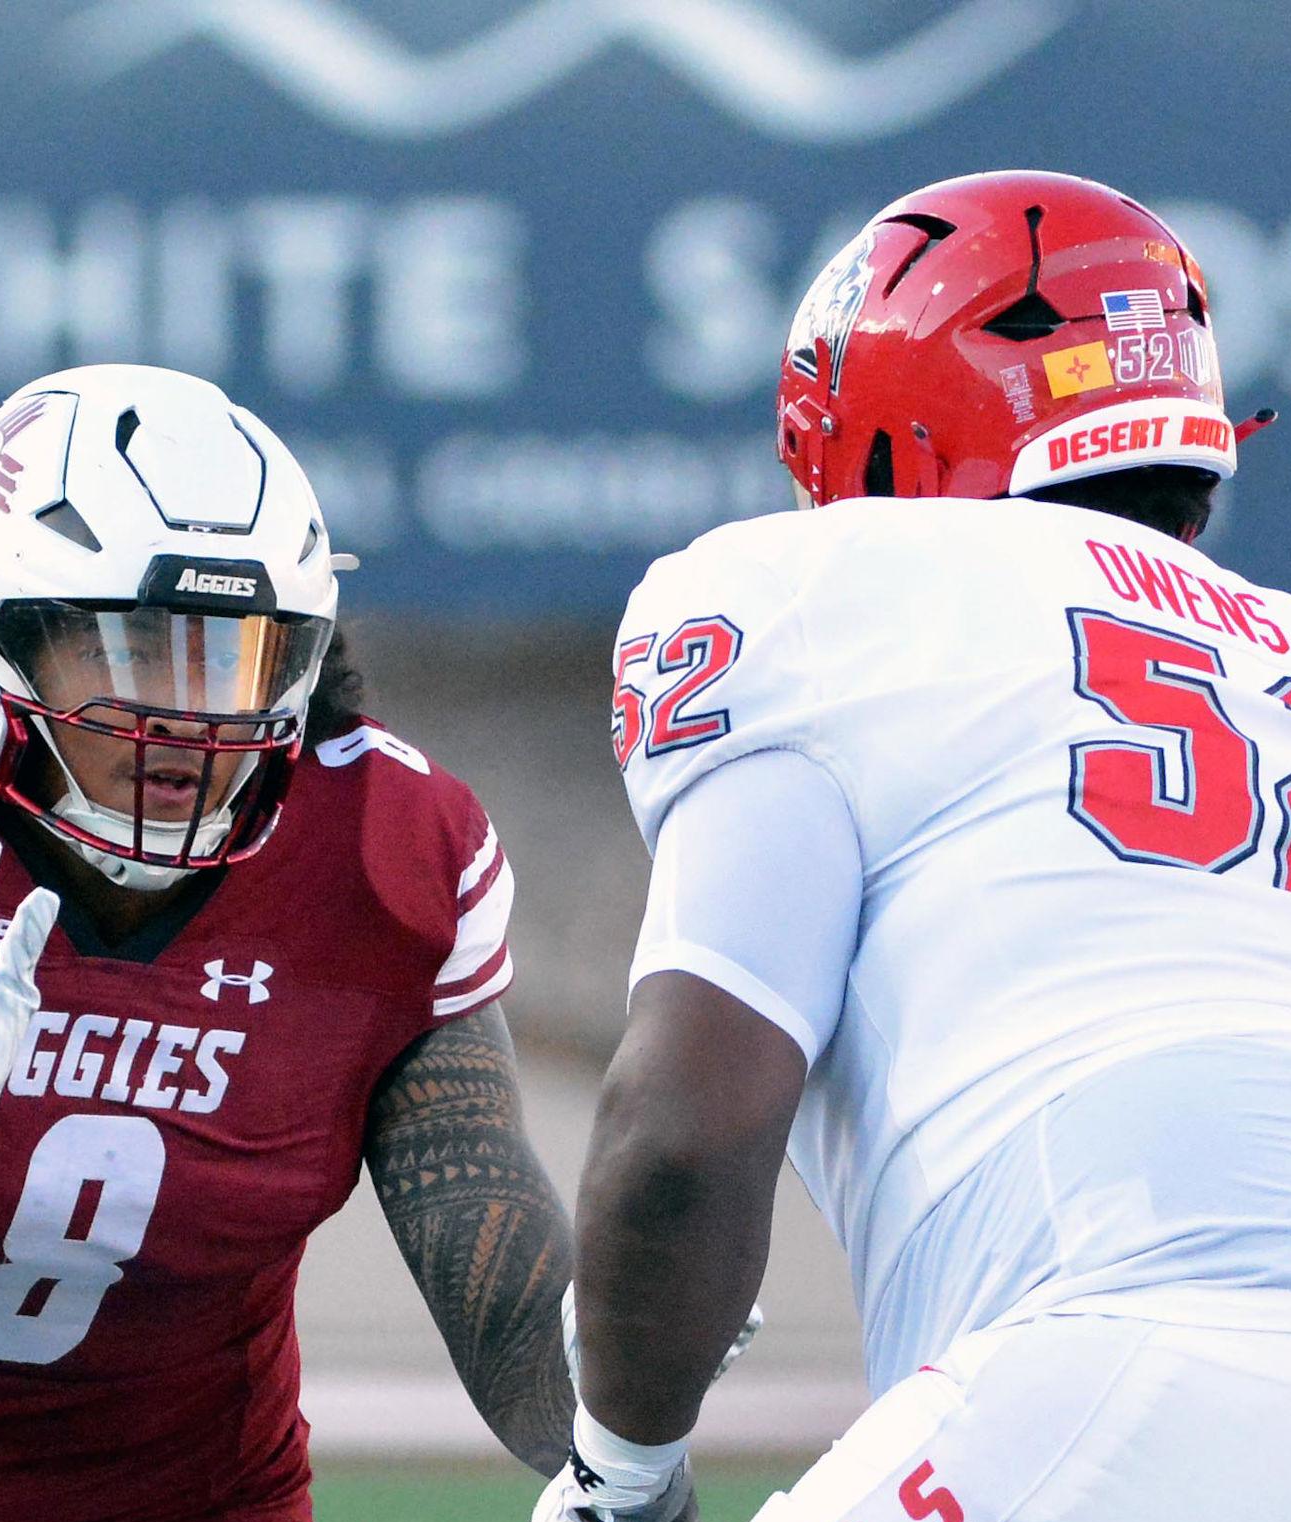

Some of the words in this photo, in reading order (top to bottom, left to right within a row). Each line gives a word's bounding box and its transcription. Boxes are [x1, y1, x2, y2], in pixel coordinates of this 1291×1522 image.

[1115, 332, 1174, 383] 52
[1048, 416, 1169, 471] DESERT
[1085, 539, 1290, 655] OWENS
[611, 614, 744, 773] 52
[7, 1010, 246, 1114] GGIES
